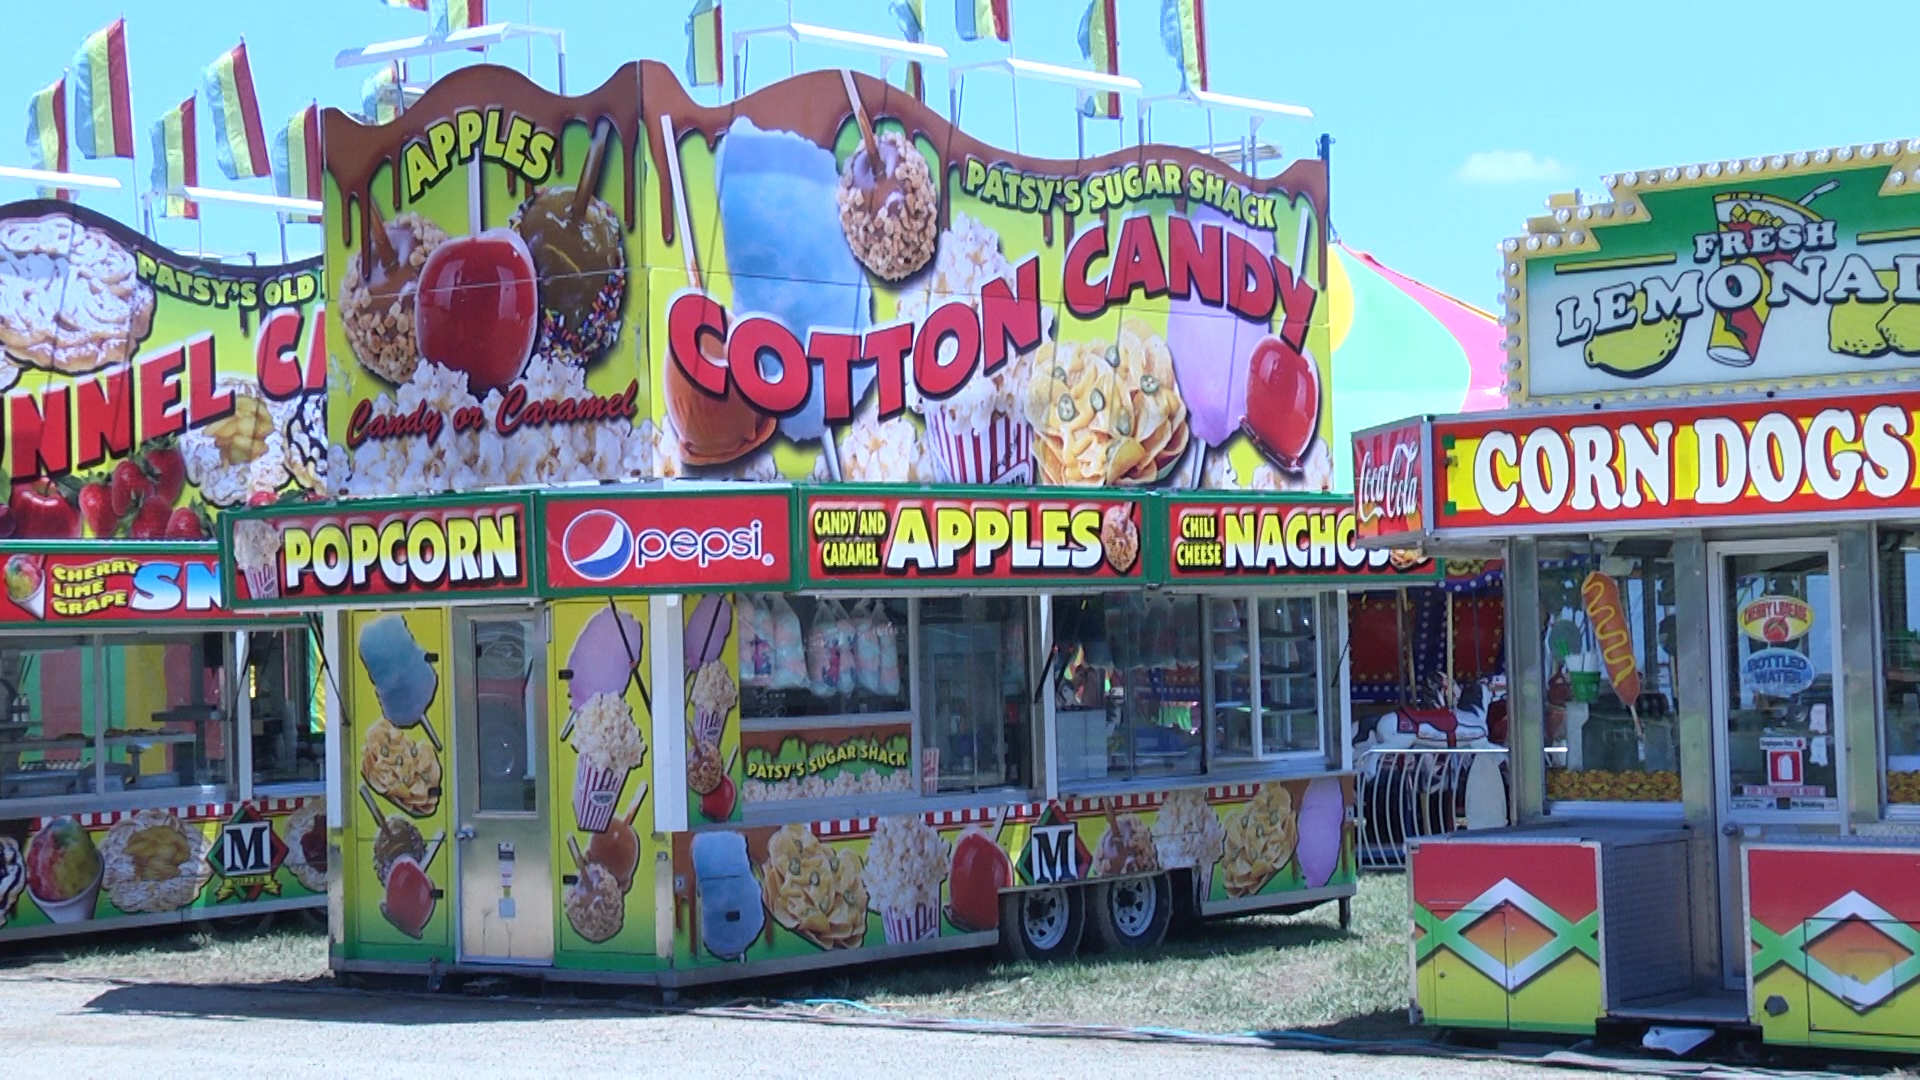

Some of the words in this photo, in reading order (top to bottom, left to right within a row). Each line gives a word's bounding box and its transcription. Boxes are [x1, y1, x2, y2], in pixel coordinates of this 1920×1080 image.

[404, 107, 555, 202] APPLES
[965, 156, 1082, 214] PATSY'S
[1088, 162, 1183, 212] SUGAR
[1187, 164, 1278, 230] SHACK
[1693, 219, 1838, 262] FRESH
[136, 251, 259, 309] PATSY'S
[262, 272, 318, 308] OLD
[667, 256, 1044, 425] COTTON
[1062, 212, 1317, 352] CANDY
[346, 398, 445, 448] Candy
[453, 404, 484, 432] or
[495, 378, 638, 432] Caramel
[1472, 420, 1674, 517] CORN
[1694, 404, 1910, 505] DOGS
[635, 519, 763, 568] pepsi
[813, 508, 857, 538] CANDY
[858, 508, 888, 537] AND
[885, 508, 1104, 571] APPLES
[1181, 514, 1217, 539] CHILI
[52, 560, 138, 582] CHERRY
[283, 514, 519, 592] POPCORN
[822, 540, 881, 568] CARAMEL
[1176, 542, 1223, 567] CHEESE
[52, 592, 127, 615] GRAPE
[53, 580, 105, 599] LIME
[1747, 654, 1808, 672] BOTTLED
[1754, 669, 1803, 684] WATER
[747, 761, 806, 781] PATSY'S
[808, 745, 856, 773] SUGAR
[859, 744, 907, 768] SHACK
[225, 826, 269, 872] M
[1033, 830, 1076, 884] M
